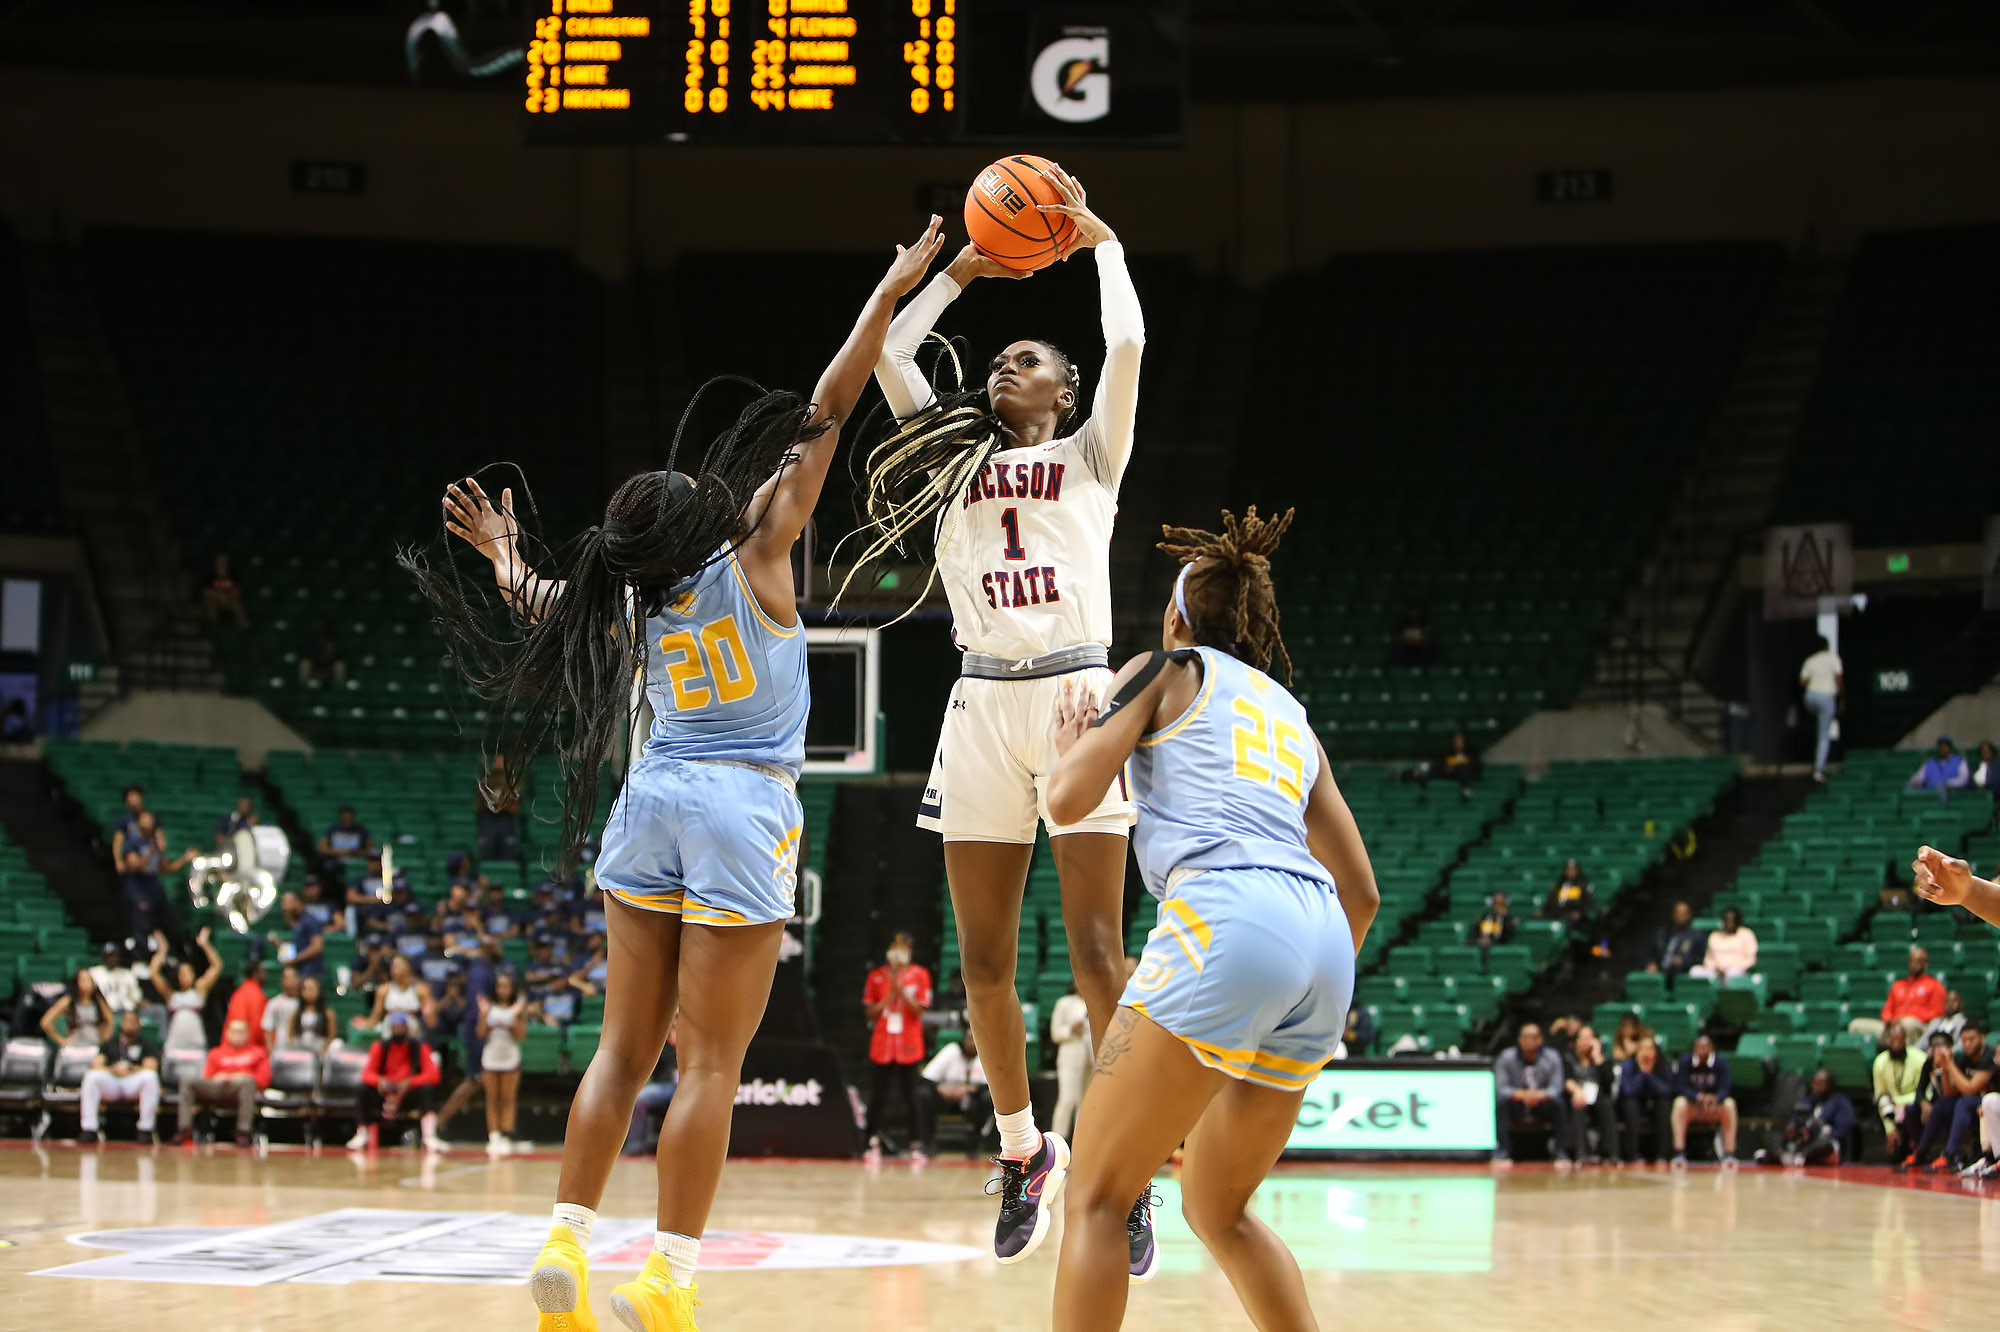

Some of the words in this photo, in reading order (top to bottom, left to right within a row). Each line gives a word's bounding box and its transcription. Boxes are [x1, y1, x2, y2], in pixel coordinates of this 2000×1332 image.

[536, 16, 562, 40] 12
[527, 40, 561, 65] 20
[686, 40, 705, 64] 2
[710, 40, 729, 65] 0
[752, 40, 786, 64] 20
[526, 64, 561, 88] 21
[685, 64, 704, 88] 2
[751, 64, 786, 89] 25
[1031, 37, 1110, 122] G
[525, 88, 560, 113] 23
[685, 88, 704, 113] 0
[709, 88, 728, 113] 0
[751, 90, 785, 111] 44
[911, 88, 930, 113] 0
[1001, 507, 1026, 560] 1
[982, 566, 1060, 610] STATE
[659, 613, 758, 711] 20
[1231, 695, 1305, 804] 25
